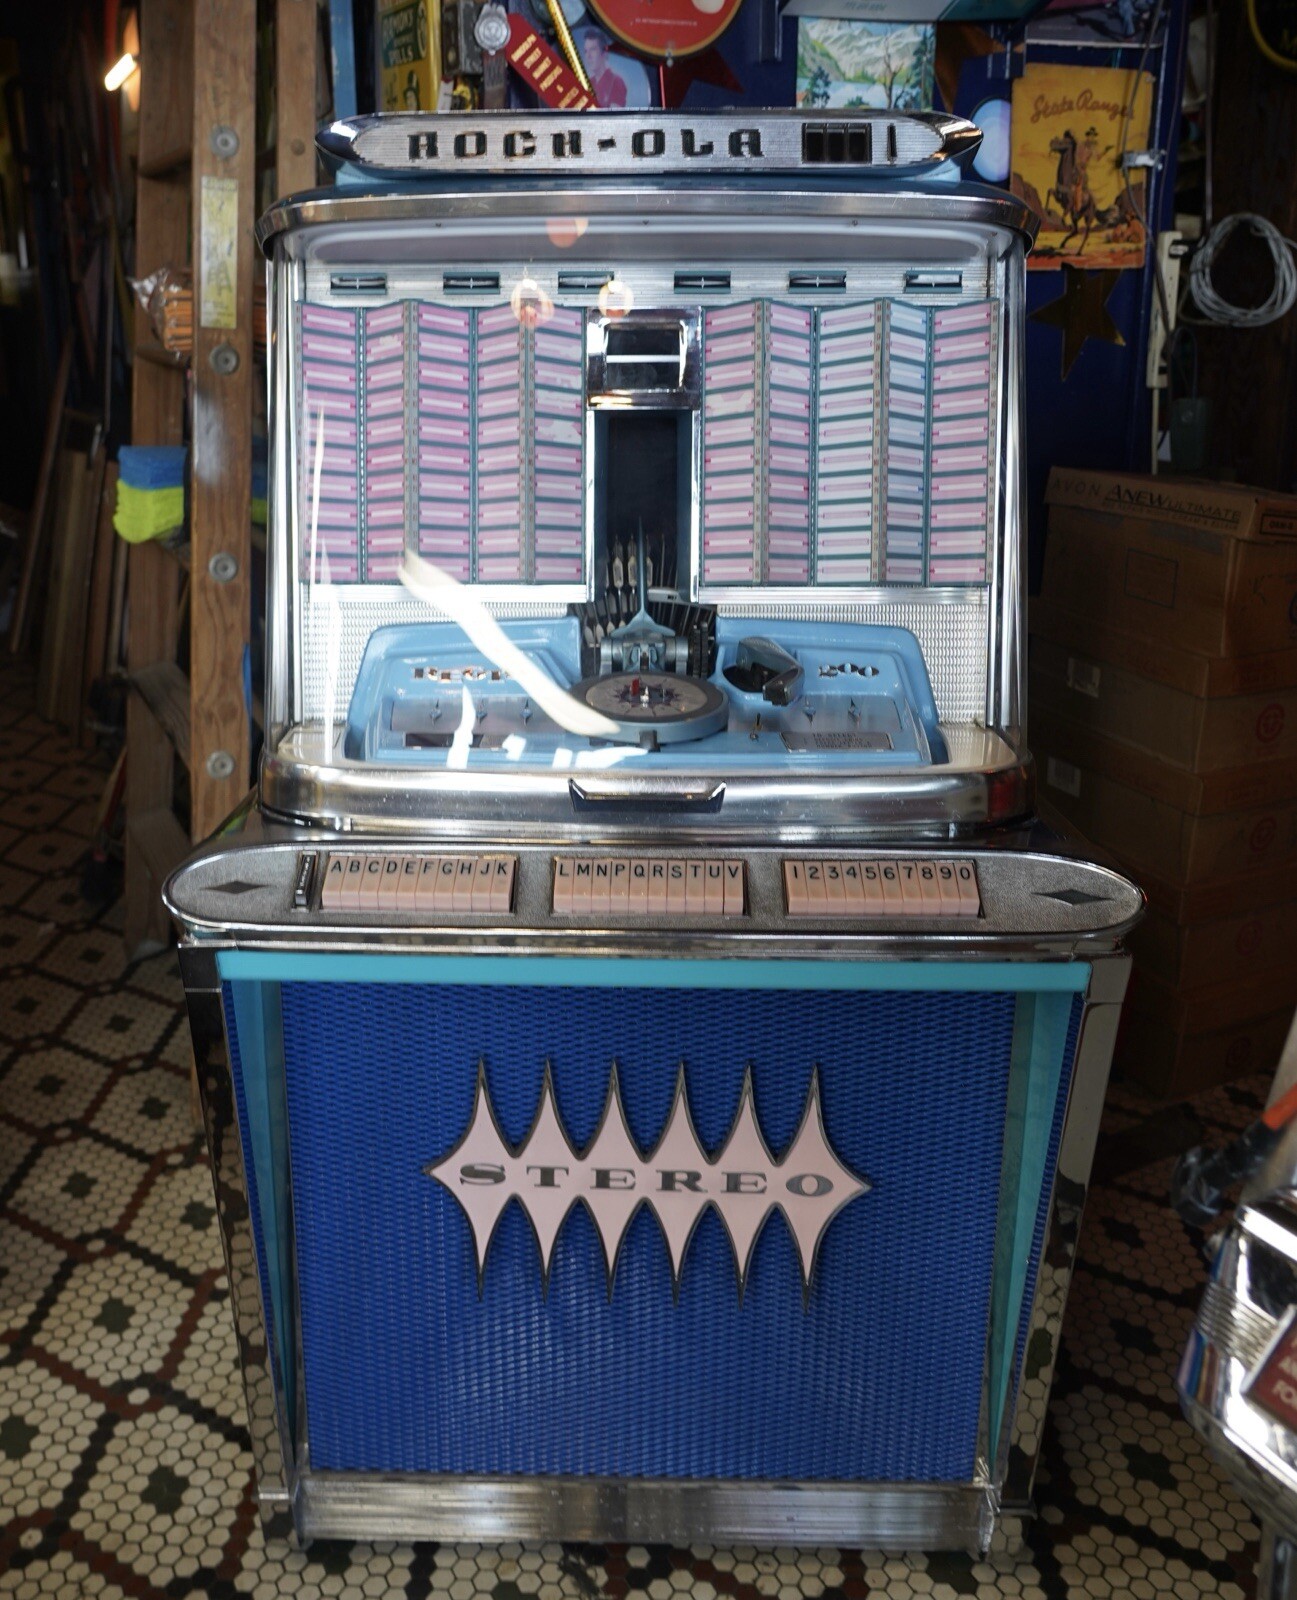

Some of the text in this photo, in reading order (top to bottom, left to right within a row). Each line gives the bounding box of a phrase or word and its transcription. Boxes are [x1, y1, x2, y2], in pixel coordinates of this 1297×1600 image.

[1030, 94, 1074, 123] State
[408, 128, 765, 161] ROCK-OLA
[1050, 478, 1101, 497] AVON
[1166, 499, 1242, 521] ULTIMATE
[459, 1162, 835, 1197] STEREO
